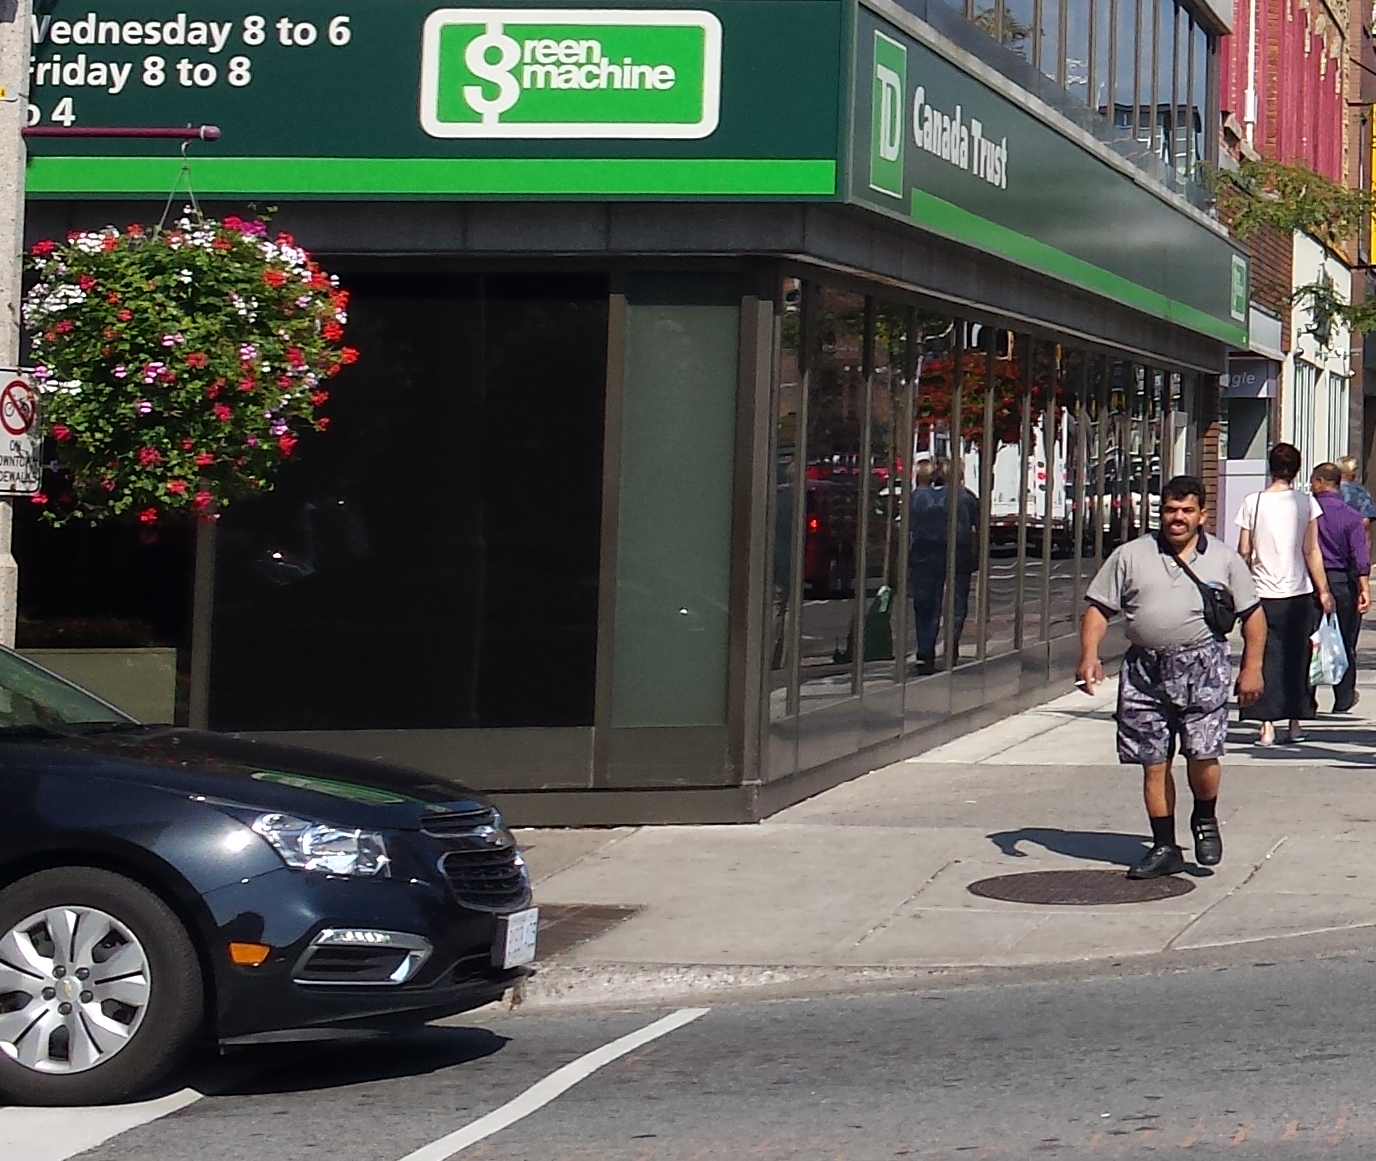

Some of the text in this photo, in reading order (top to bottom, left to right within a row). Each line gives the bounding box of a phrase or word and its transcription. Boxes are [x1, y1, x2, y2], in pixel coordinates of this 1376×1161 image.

[242, 15, 266, 46] 8
[276, 17, 318, 46] to
[328, 15, 352, 46] 6
[142, 56, 166, 87] 8
[176, 58, 217, 87] to
[227, 56, 252, 87] 8
[521, 56, 676, 91] machine
[51, 96, 77, 127] 4
[877, 63, 1008, 190] TD Canada Trust
